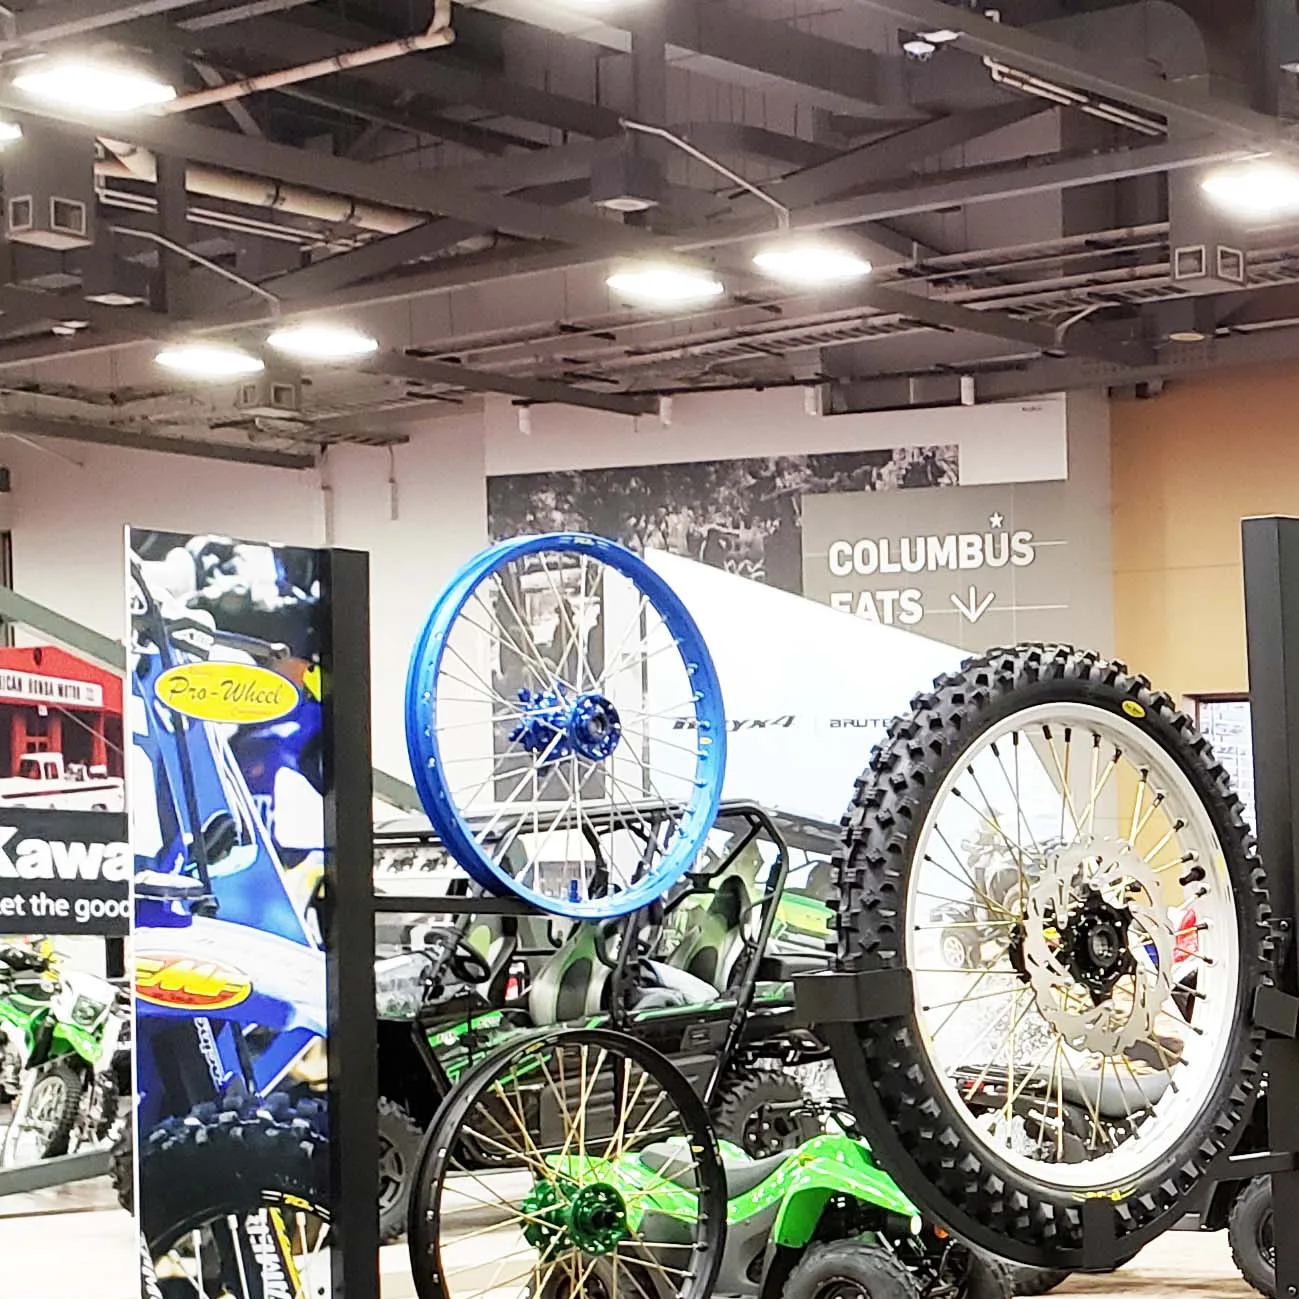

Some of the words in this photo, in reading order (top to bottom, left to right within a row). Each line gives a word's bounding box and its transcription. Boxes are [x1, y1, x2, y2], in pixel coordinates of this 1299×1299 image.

[828, 531, 1036, 576] COLUMBUS
[168, 675, 284, 705] Pro-Wheel
[0, 894, 26, 917] et
[29, 891, 70, 917] the
